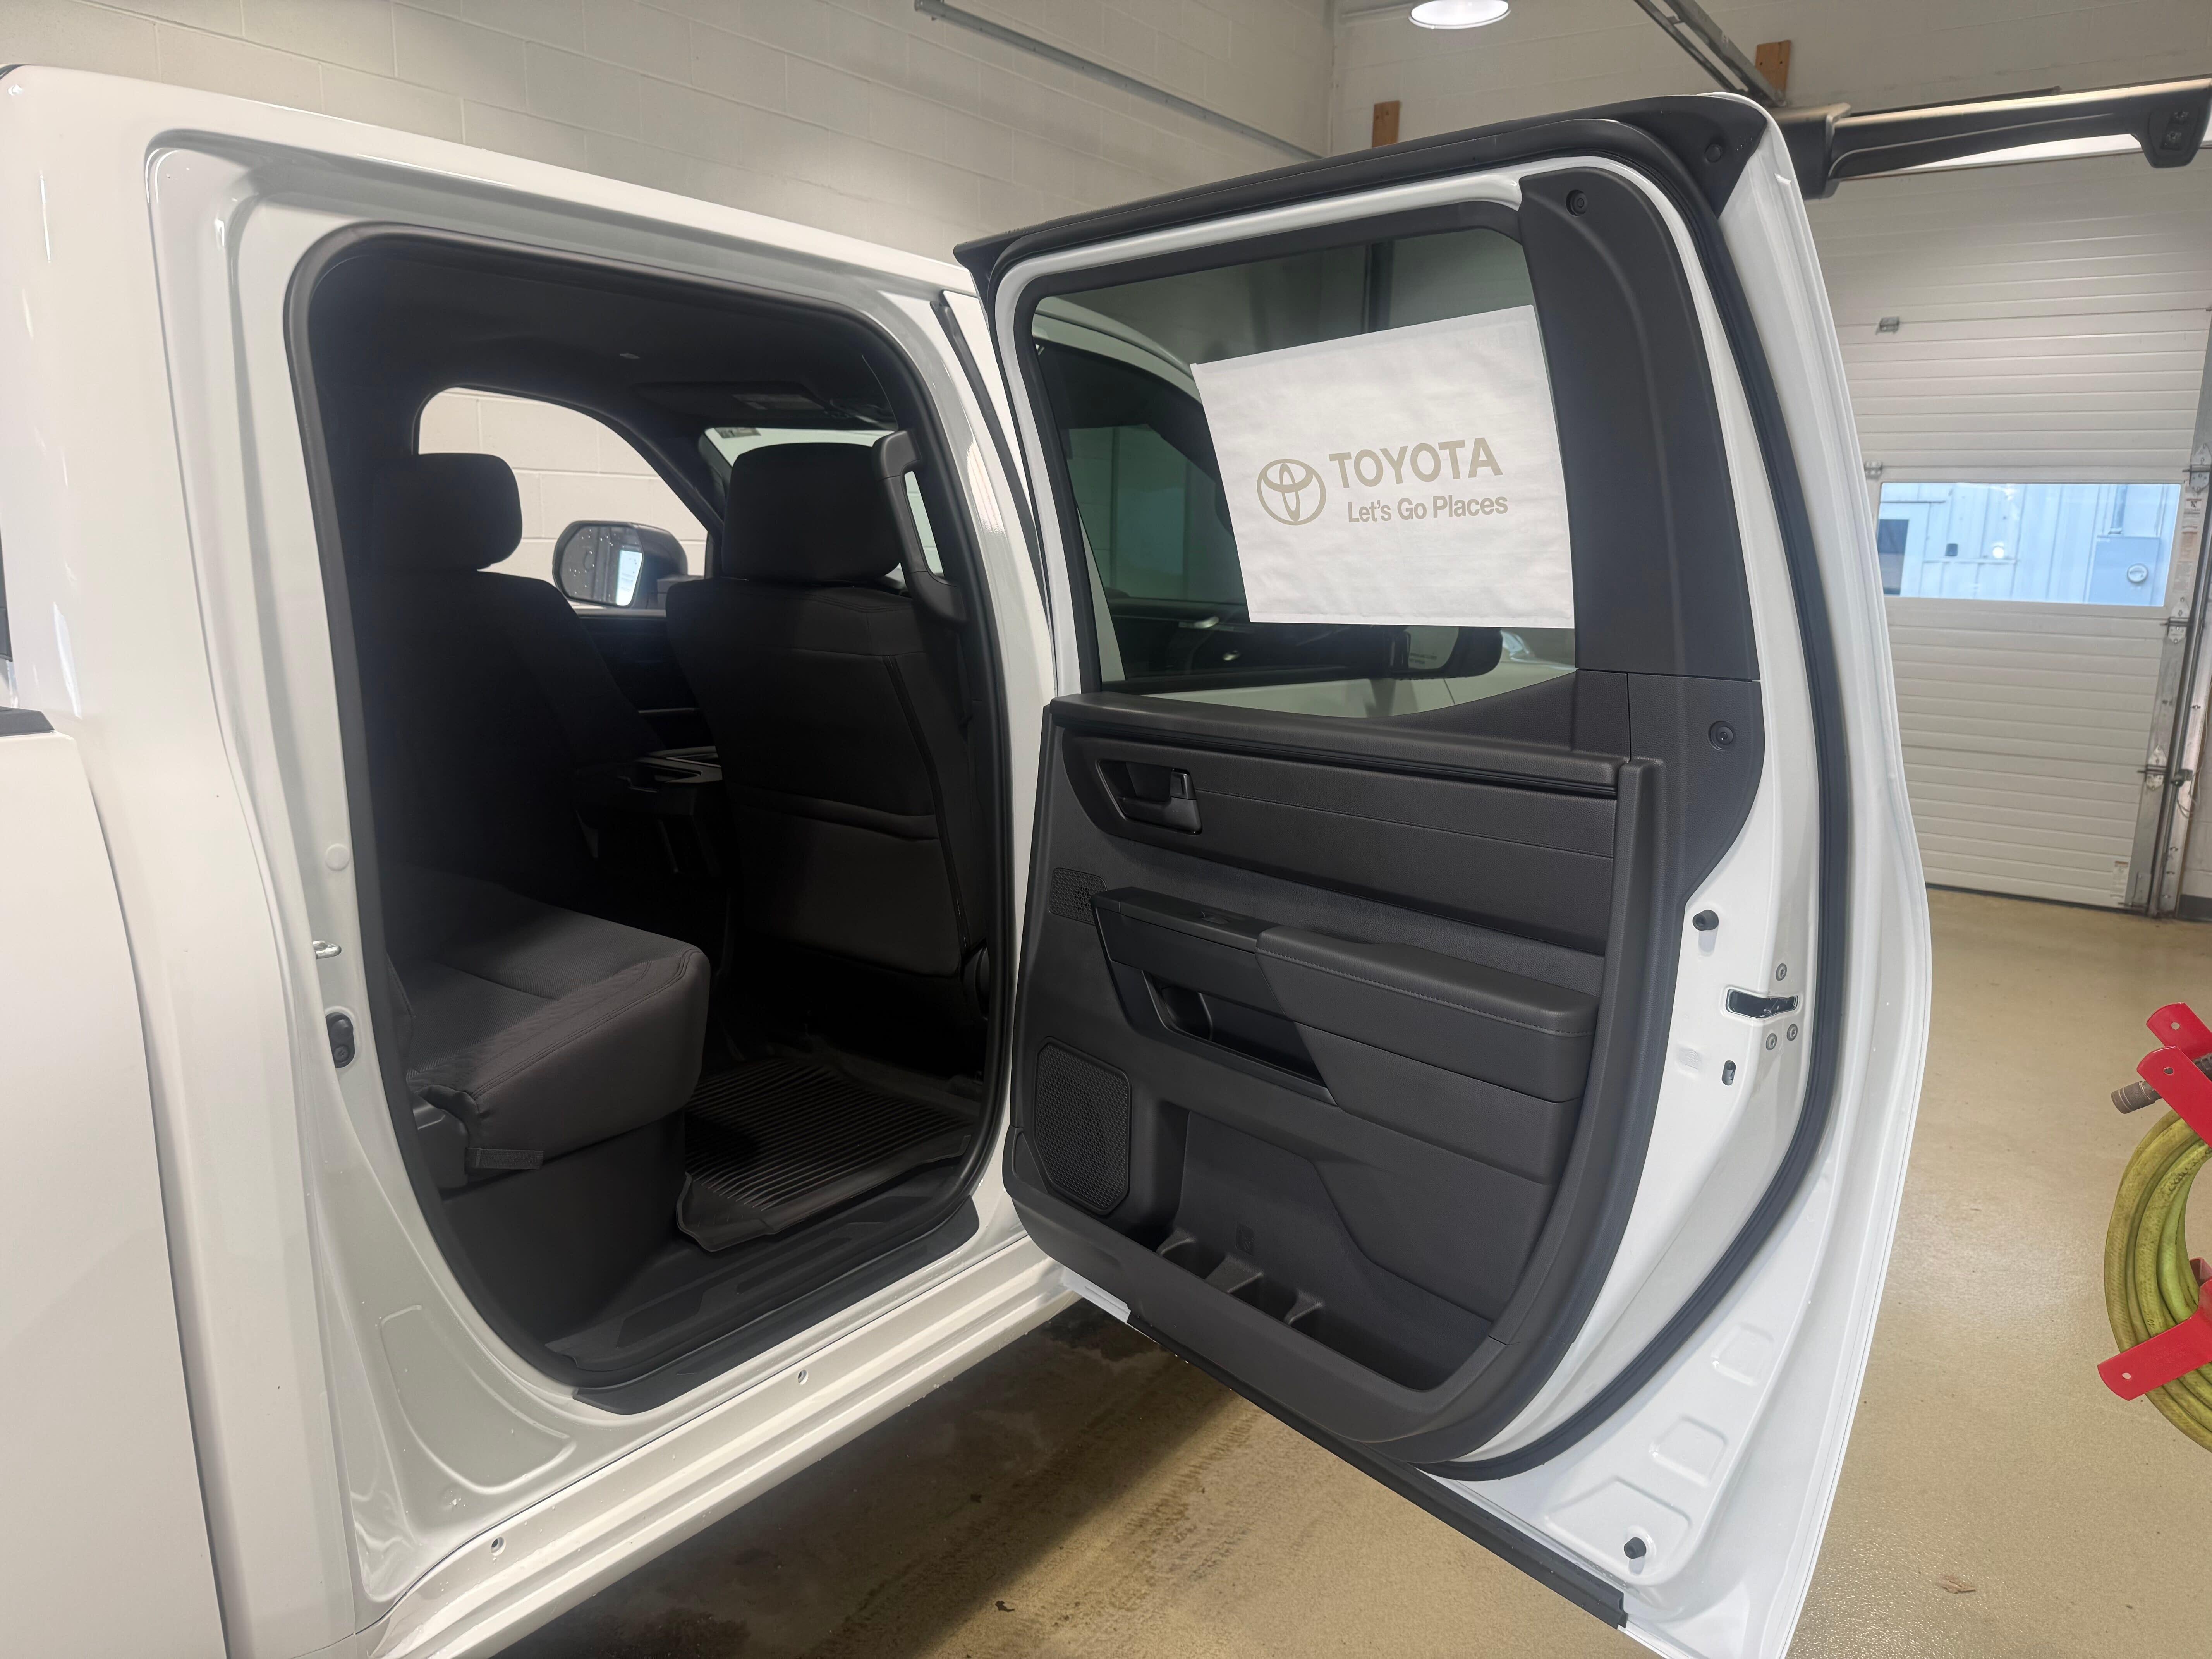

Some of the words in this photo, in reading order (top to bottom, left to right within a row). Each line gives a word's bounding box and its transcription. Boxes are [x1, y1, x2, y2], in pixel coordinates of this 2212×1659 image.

[1329, 437, 1503, 488] TOYOTA
[1348, 500, 1391, 523] Let's
[1397, 498, 1427, 520] Go
[1432, 495, 1508, 518] Places
